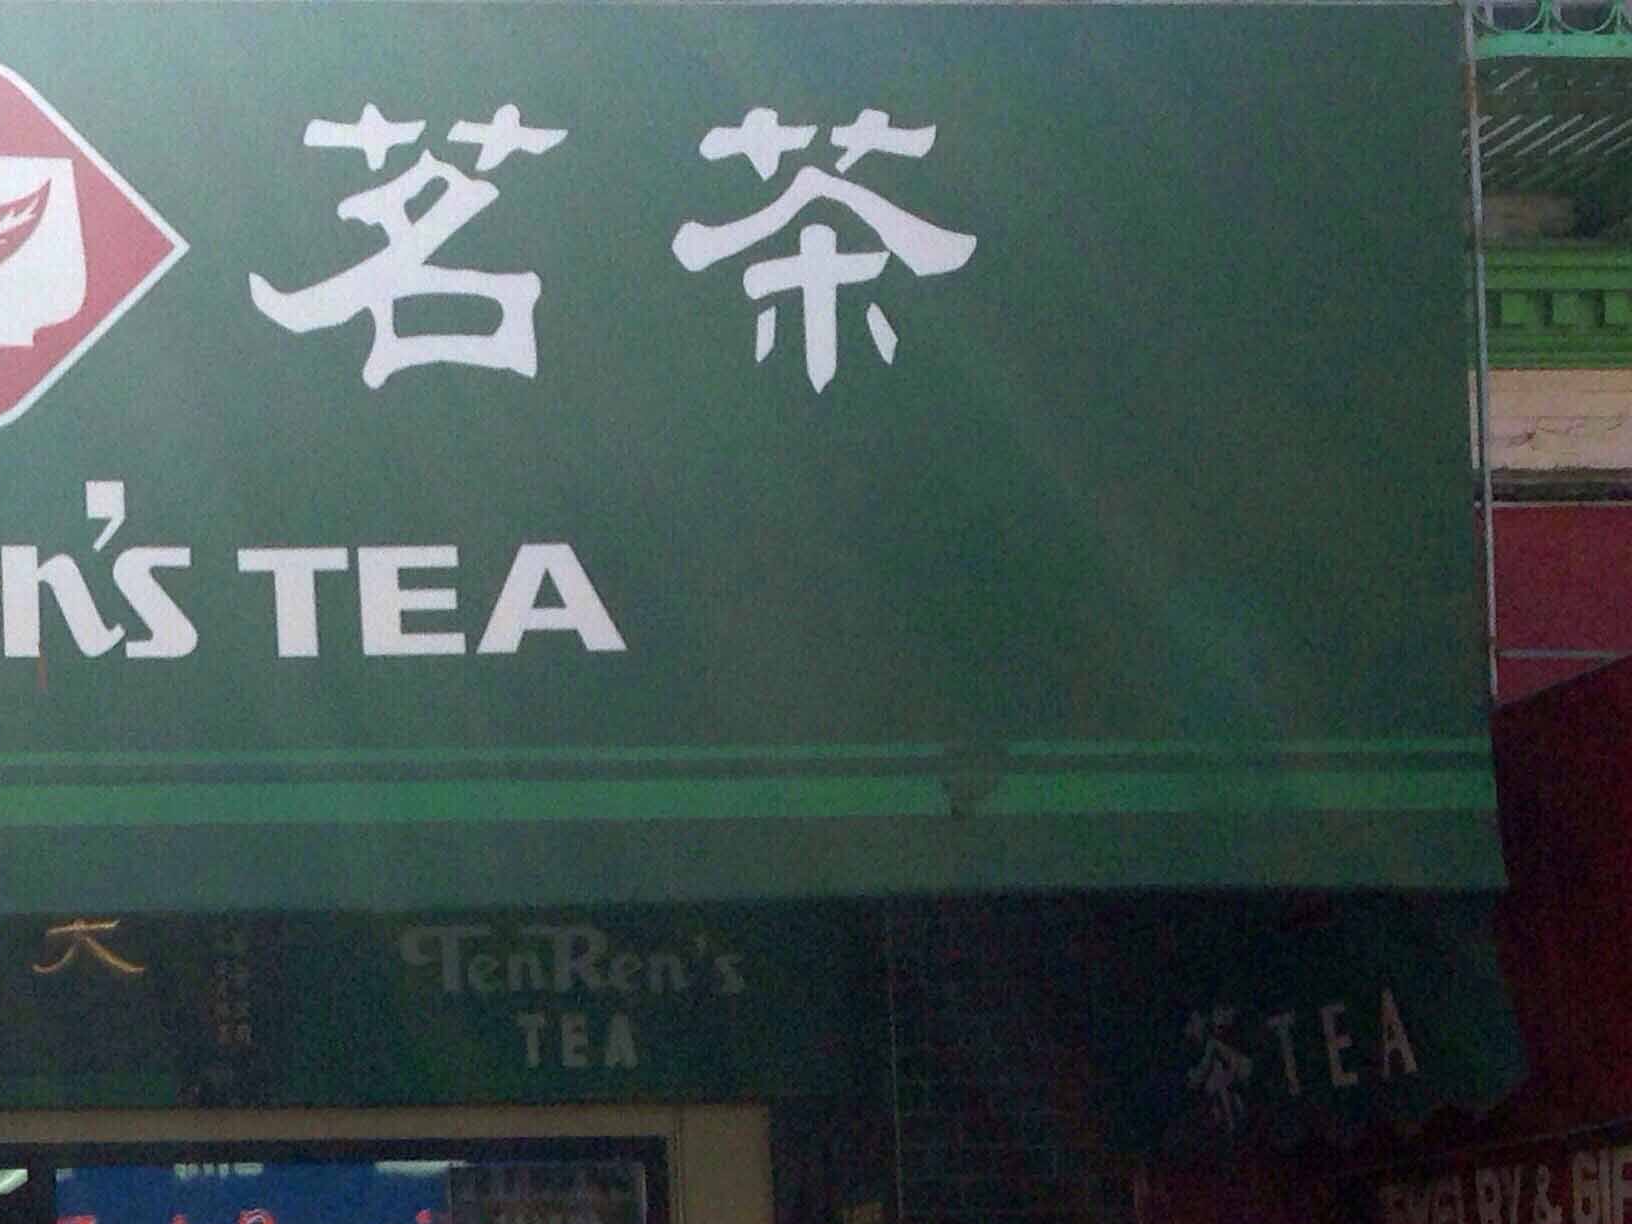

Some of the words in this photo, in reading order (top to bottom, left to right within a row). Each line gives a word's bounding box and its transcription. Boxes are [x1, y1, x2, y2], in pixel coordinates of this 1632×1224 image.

[237, 543, 628, 657] TEA
[516, 1010, 639, 1068] TEA
[1266, 988, 1420, 1096] TEA
